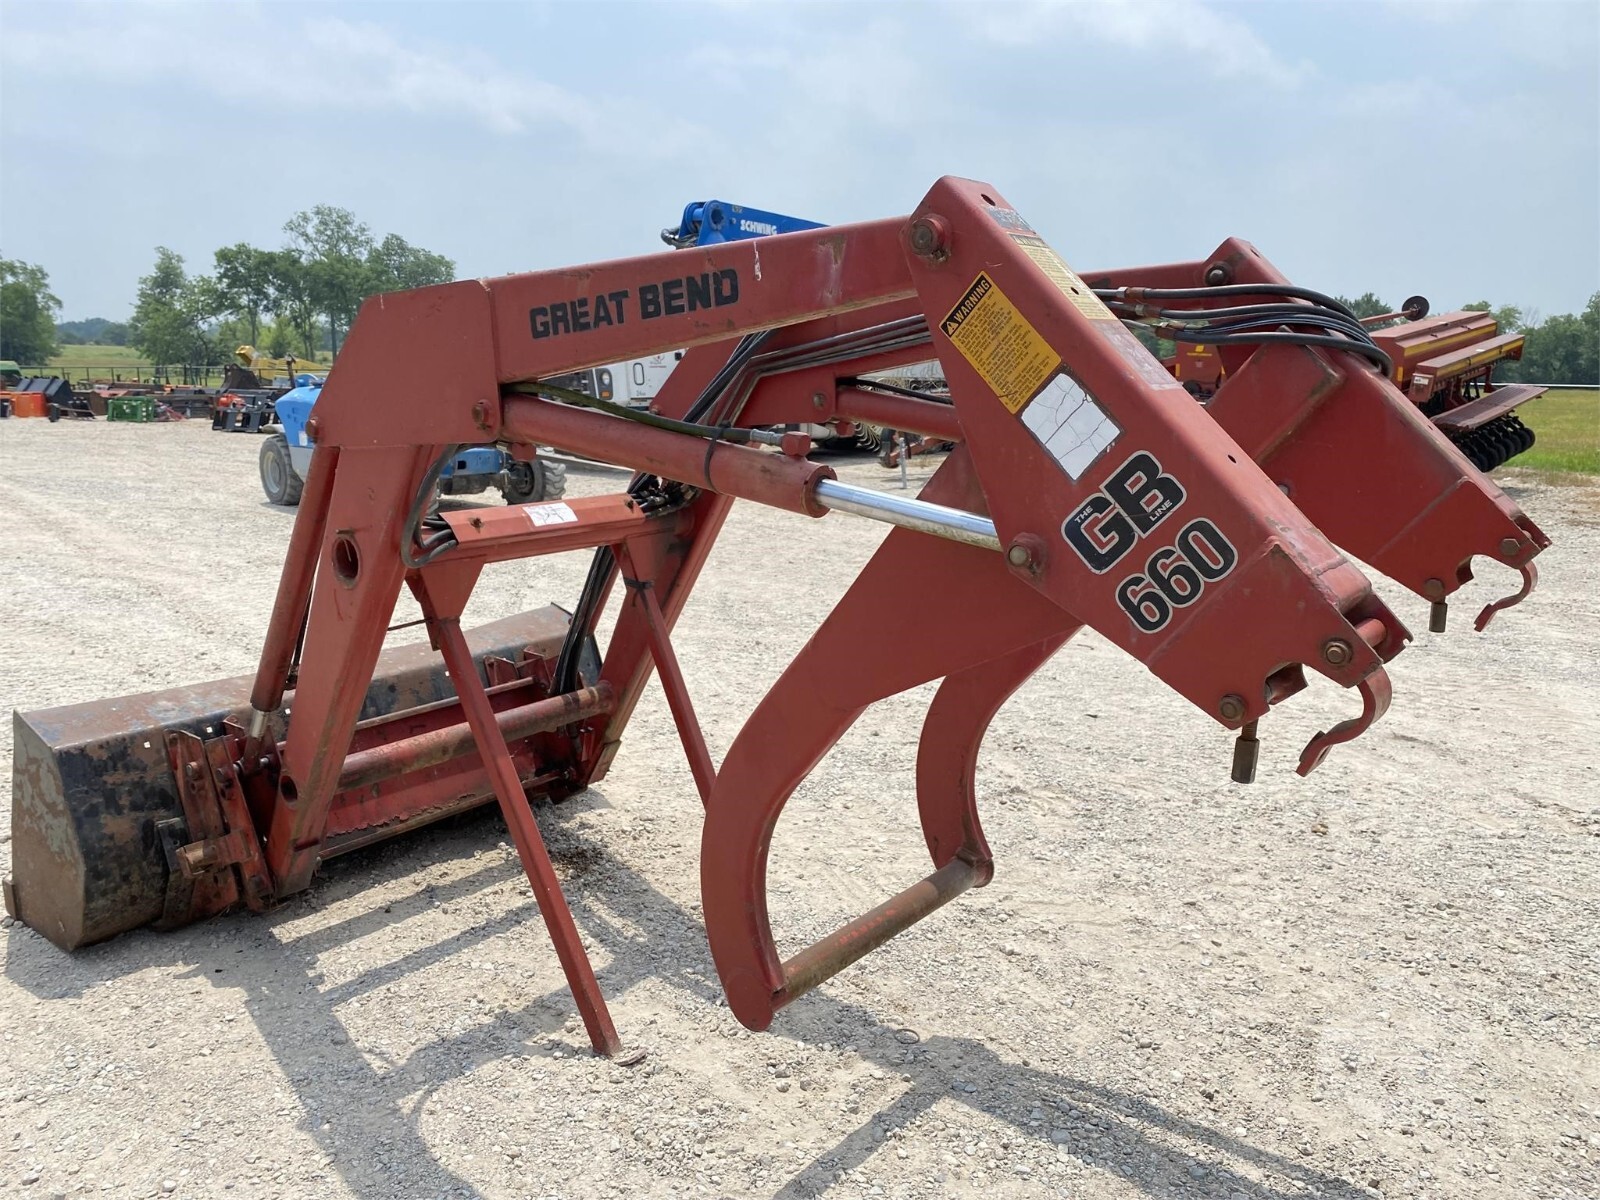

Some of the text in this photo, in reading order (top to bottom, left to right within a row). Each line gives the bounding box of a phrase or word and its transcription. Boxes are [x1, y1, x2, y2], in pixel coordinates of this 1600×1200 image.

[740, 219, 778, 236] SCHWING
[530, 268, 739, 339] GREAT BEND
[953, 279, 990, 323] WARNING
[1061, 450, 1187, 575] GB
[1074, 505, 1094, 523] THE
[1149, 499, 1173, 522] LINE
[1115, 517, 1239, 634] 660
